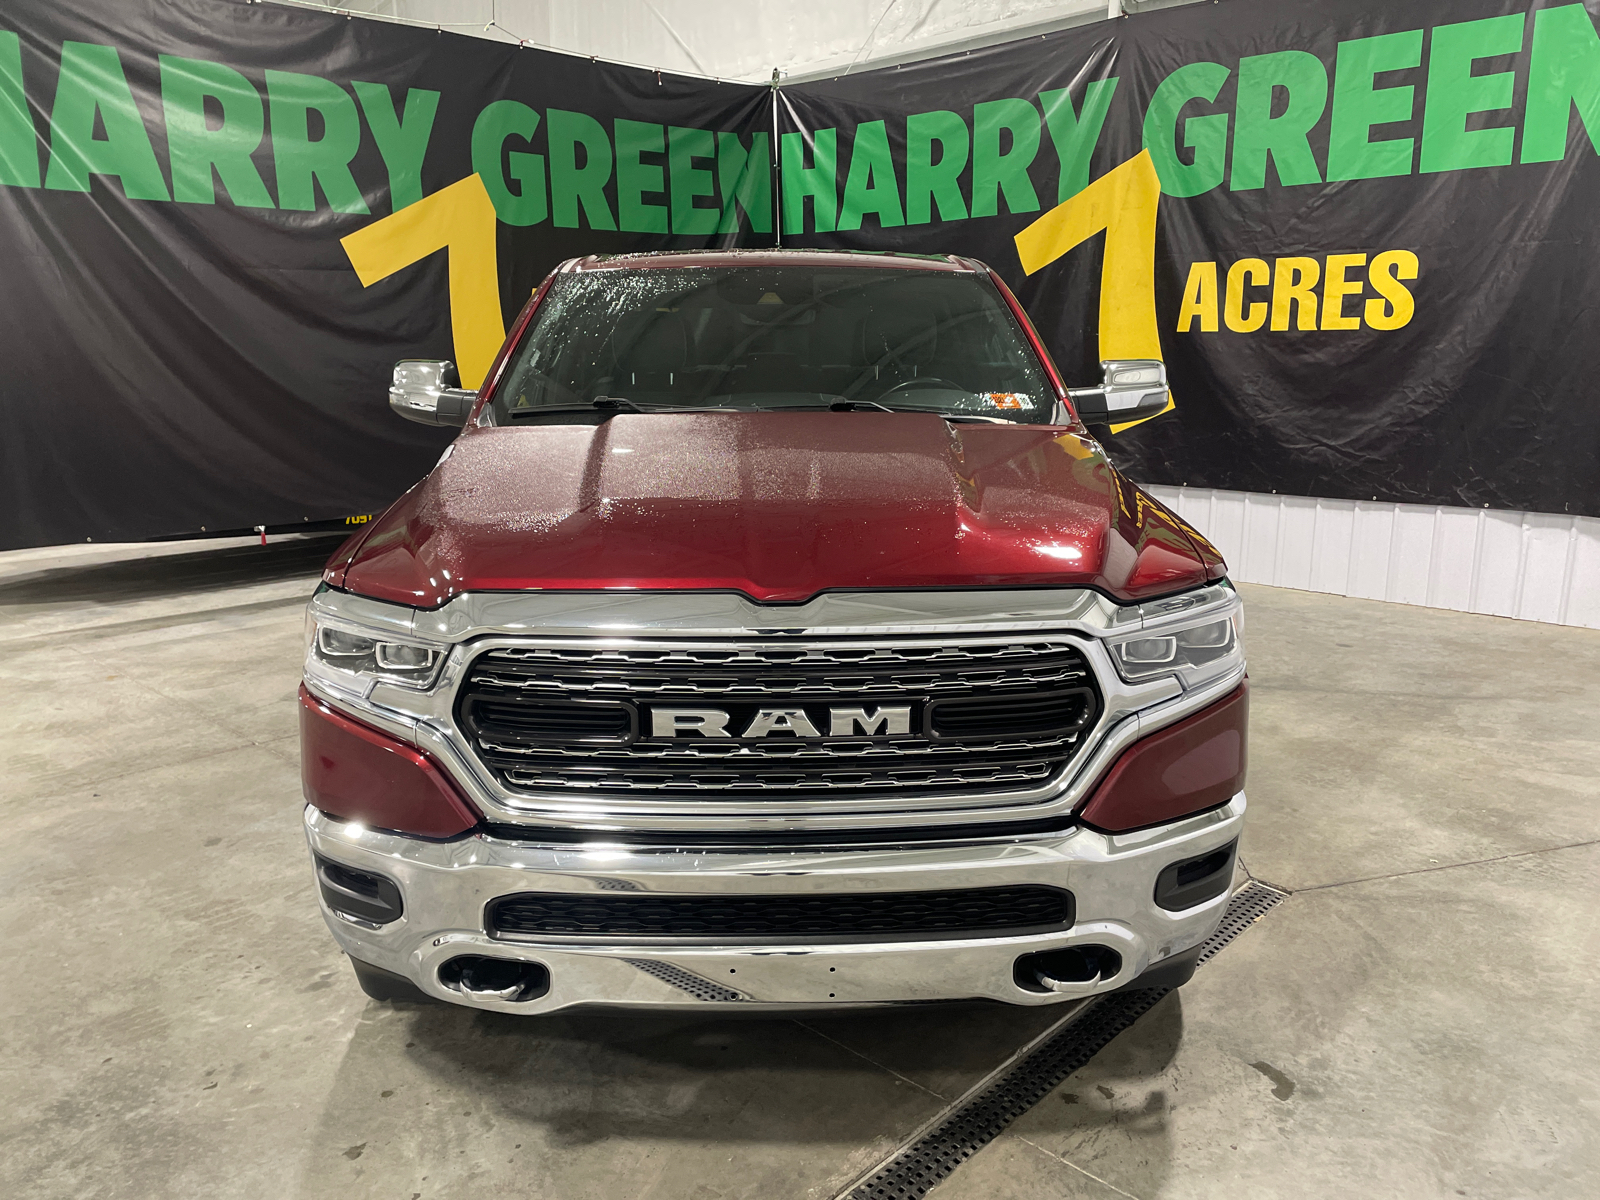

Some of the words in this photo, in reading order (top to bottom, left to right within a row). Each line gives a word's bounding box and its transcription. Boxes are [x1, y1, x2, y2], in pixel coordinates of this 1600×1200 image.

[471, 100, 773, 235] GREEN
[781, 77, 1119, 235] HARRY
[340, 172, 506, 390] 7
[1014, 148, 1176, 434] 7
[1176, 250, 1420, 333] ACRES
[651, 707, 911, 737] RAM
